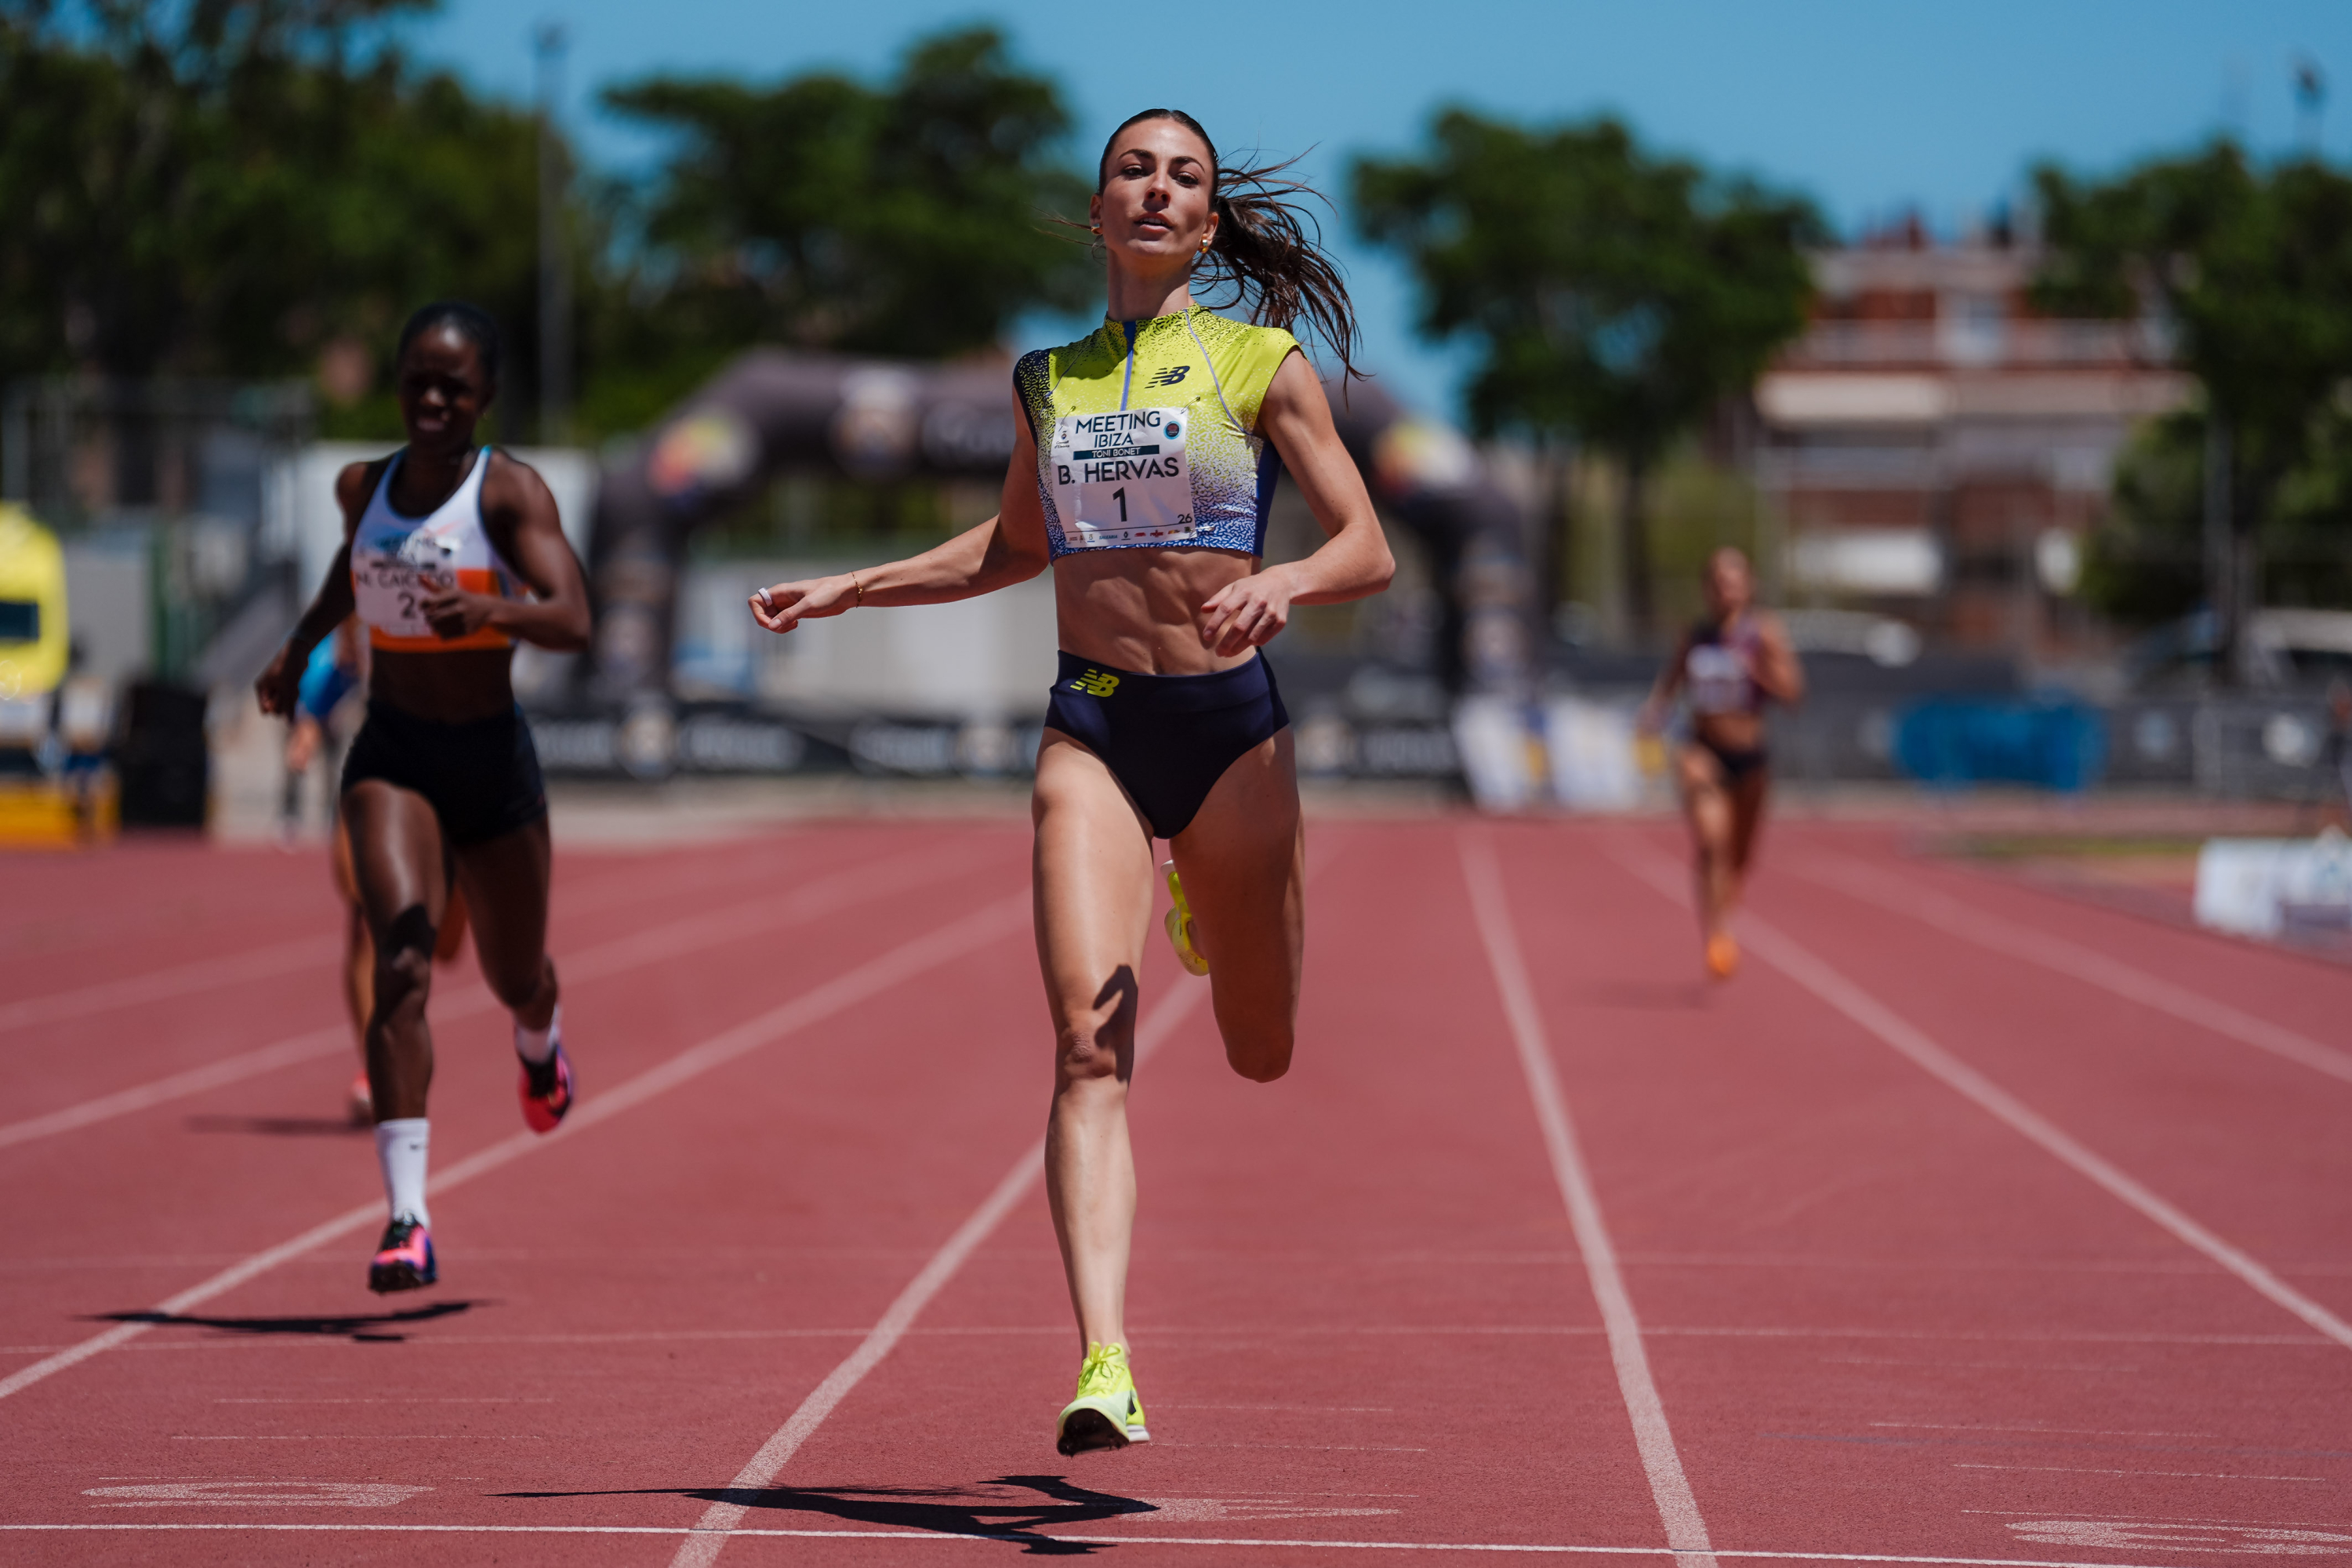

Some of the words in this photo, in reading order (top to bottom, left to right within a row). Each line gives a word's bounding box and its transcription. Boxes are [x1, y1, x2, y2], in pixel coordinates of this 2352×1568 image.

[1075, 411, 1160, 434] MEETING
[1094, 433, 1134, 448] IBIZA
[1112, 447, 1141, 456] BONET
[1058, 465, 1076, 485] B.
[1084, 457, 1179, 483] HERVAS
[1112, 486, 1127, 522] 1
[1177, 514, 1192, 524] 26
[397, 591, 416, 619] 2
